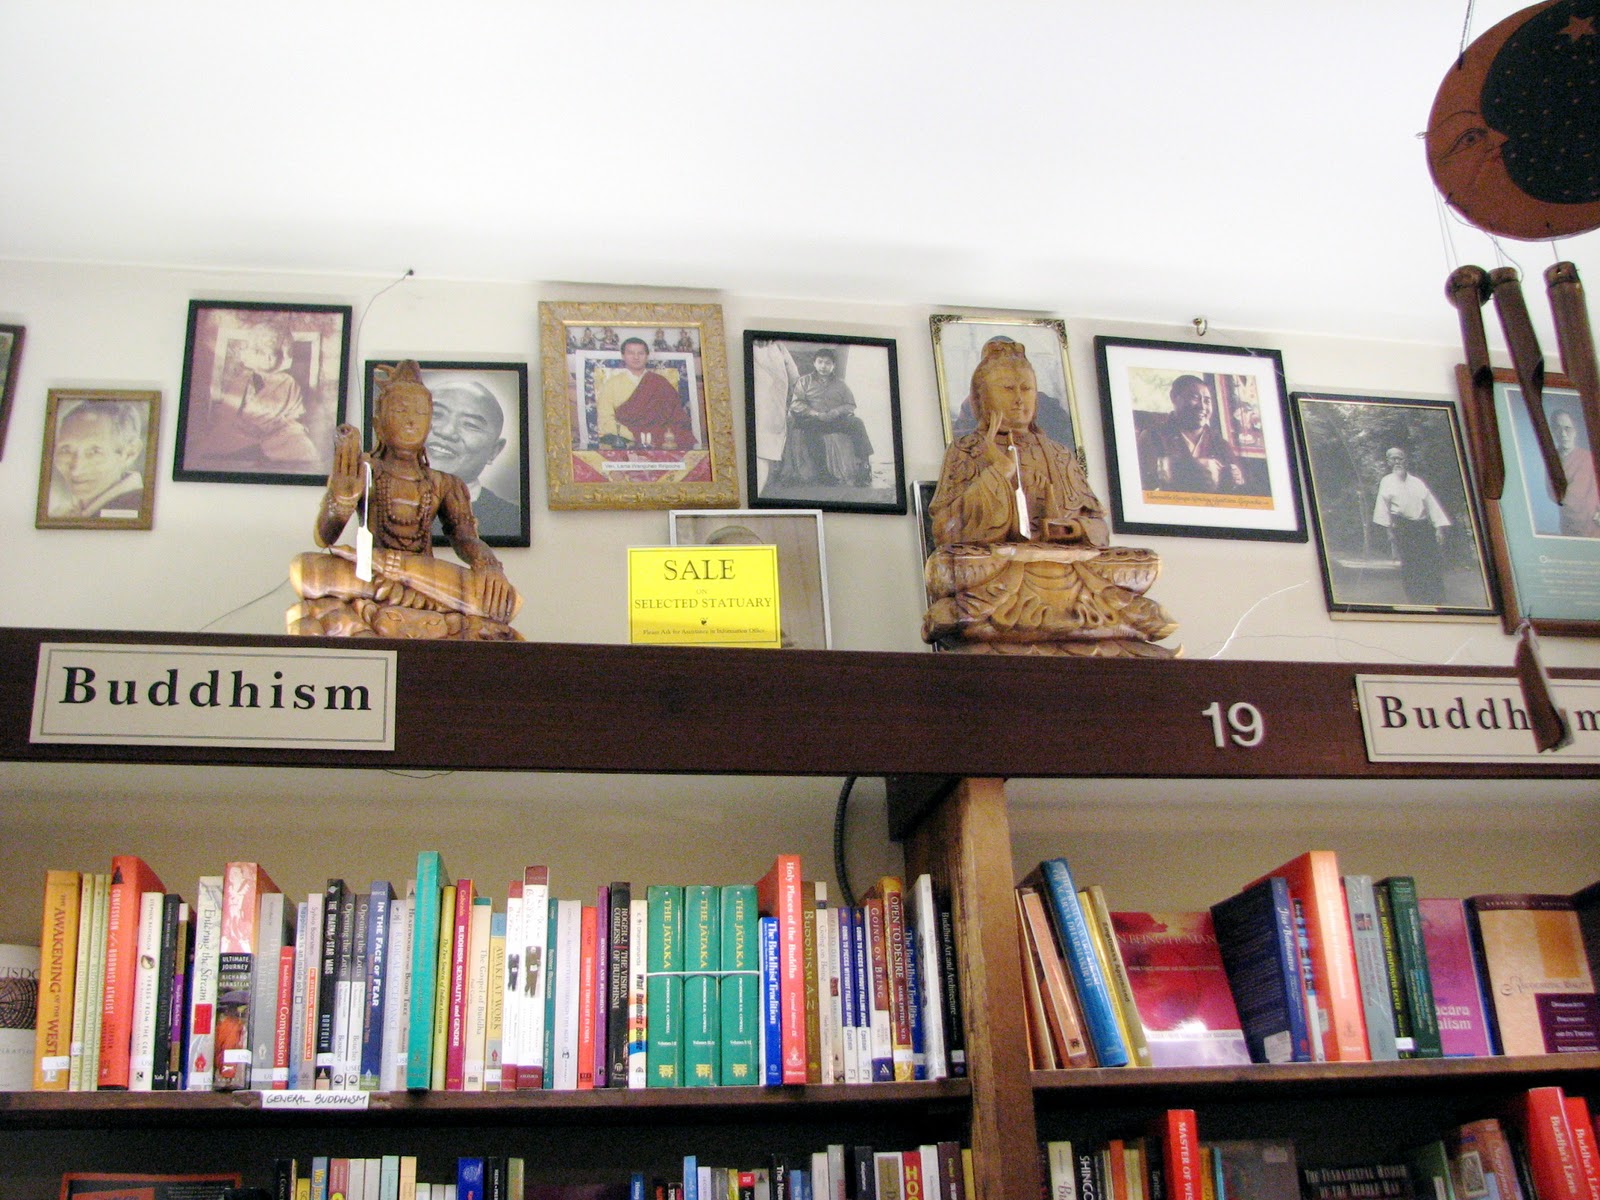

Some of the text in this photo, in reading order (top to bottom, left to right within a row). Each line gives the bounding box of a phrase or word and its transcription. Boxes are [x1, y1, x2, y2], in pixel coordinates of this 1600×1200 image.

[664, 559, 736, 580] SALE
[634, 598, 772, 609] SELECTED STATUARY
[59, 666, 372, 711] Buddhism
[1202, 702, 1263, 748] 19
[1376, 696, 1600, 731] Buddhm
[786, 862, 794, 882] Holy
[787, 885, 795, 913] Places
[890, 896, 900, 924] OPEN
[310, 907, 318, 925] Sylvia
[341, 903, 352, 937] Opening
[356, 904, 368, 938] Opening
[406, 908, 415, 951] HEARTWOOD
[612, 907, 621, 944] CORLESS
[788, 915, 795, 925] of
[941, 912, 951, 943] Buddhist
[1277, 907, 1290, 924] Jizo
[341, 939, 350, 953] the
[356, 940, 366, 953] the
[788, 927, 796, 941] the
[893, 927, 901, 942] TO
[1282, 925, 1296, 972] Bodhisattva
[49, 907, 66, 993] AWAKENING
[199, 908, 216, 1002] Entering the Stream
[340, 954, 350, 977] Lotus
[372, 901, 385, 1006] IN THE FACE OF FEAR
[820, 949, 826, 959] on
[870, 907, 884, 999] GOING ON BEING
[893, 944, 903, 978] DESIRE
[944, 944, 952, 956] Art
[1102, 922, 1130, 1002] Emptiness Appraised
[356, 955, 365, 978] Lotus
[389, 932, 402, 1030] RADICAL ACCEPTANCE
[477, 966, 486, 991] Gospel
[611, 950, 620, 1009] OF BUDDHISM
[636, 974, 644, 990] What
[768, 921, 779, 1024] The Buddhist Tradition
[905, 930, 917, 1028] The Buddhist Tradition
[403, 972, 411, 995] BODHI
[494, 984, 501, 997] AT
[946, 972, 957, 1015] Architecture
[477, 995, 485, 1004] of
[635, 993, 644, 1025] Buddhists
[320, 1014, 330, 1048] BORTOLIN
[476, 1006, 485, 1035] Buddha
[46, 1020, 59, 1056] WEST
[635, 1027, 644, 1050] Believe
[266, 1095, 366, 1104] GENERAL BUDDHISM
[1179, 1122, 1190, 1165] MASTER
[1550, 1116, 1577, 1194] Buddha's Lions
[1575, 1128, 1595, 1175] Buddha's
[1182, 1167, 1190, 1180] OF
